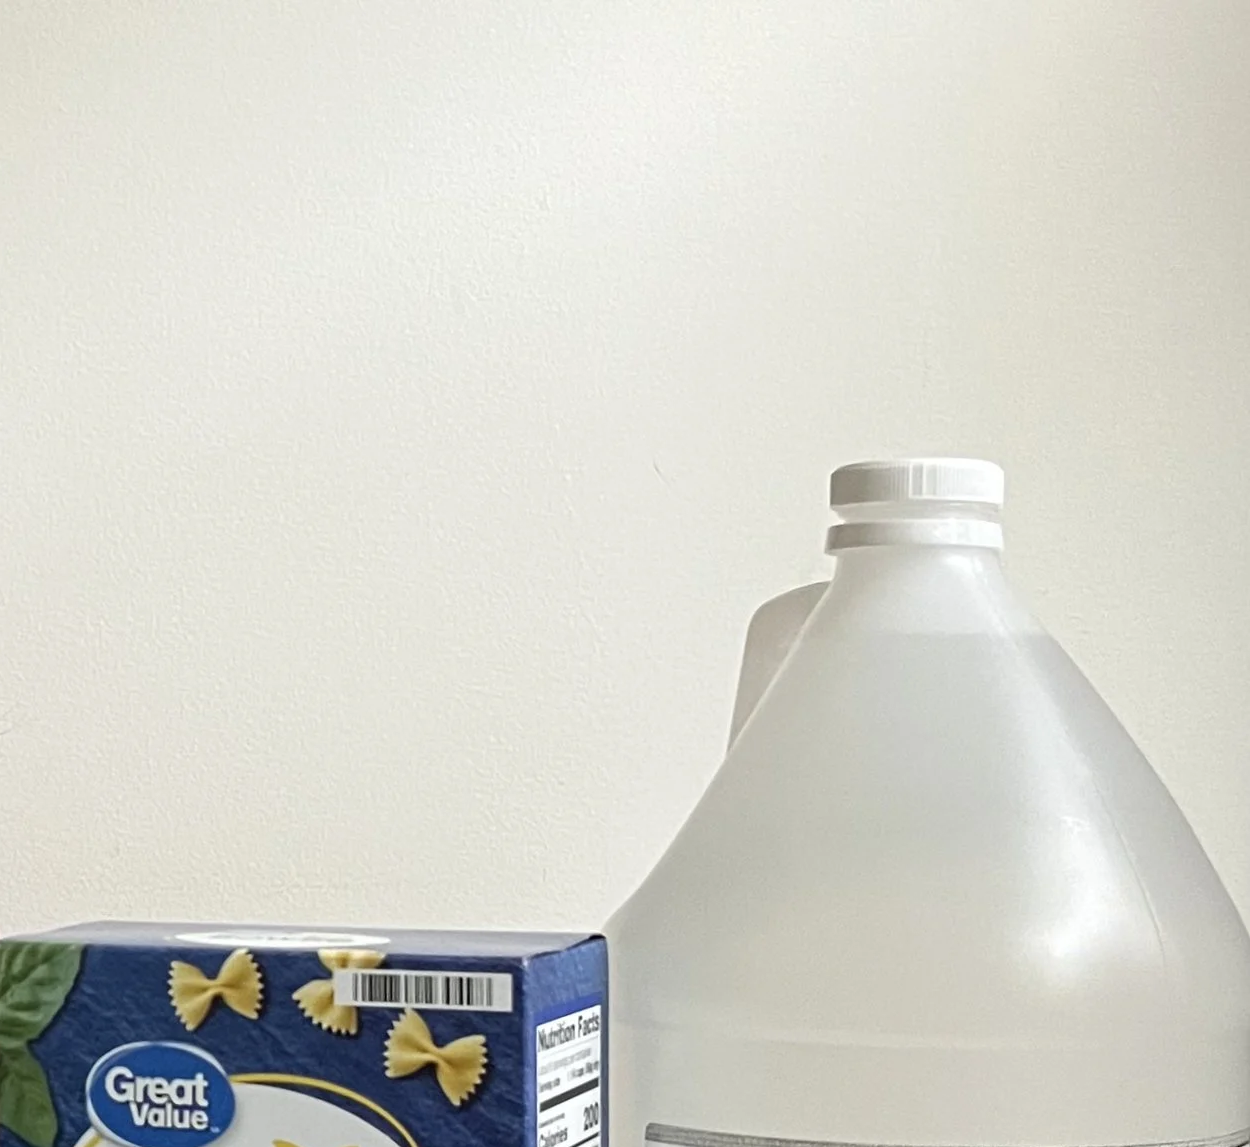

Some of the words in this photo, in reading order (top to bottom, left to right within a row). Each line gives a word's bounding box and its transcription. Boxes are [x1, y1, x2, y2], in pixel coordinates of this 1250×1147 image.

[104, 1066, 209, 1107] Great
[129, 1103, 209, 1130] Value
[583, 1102, 599, 1131] 200
